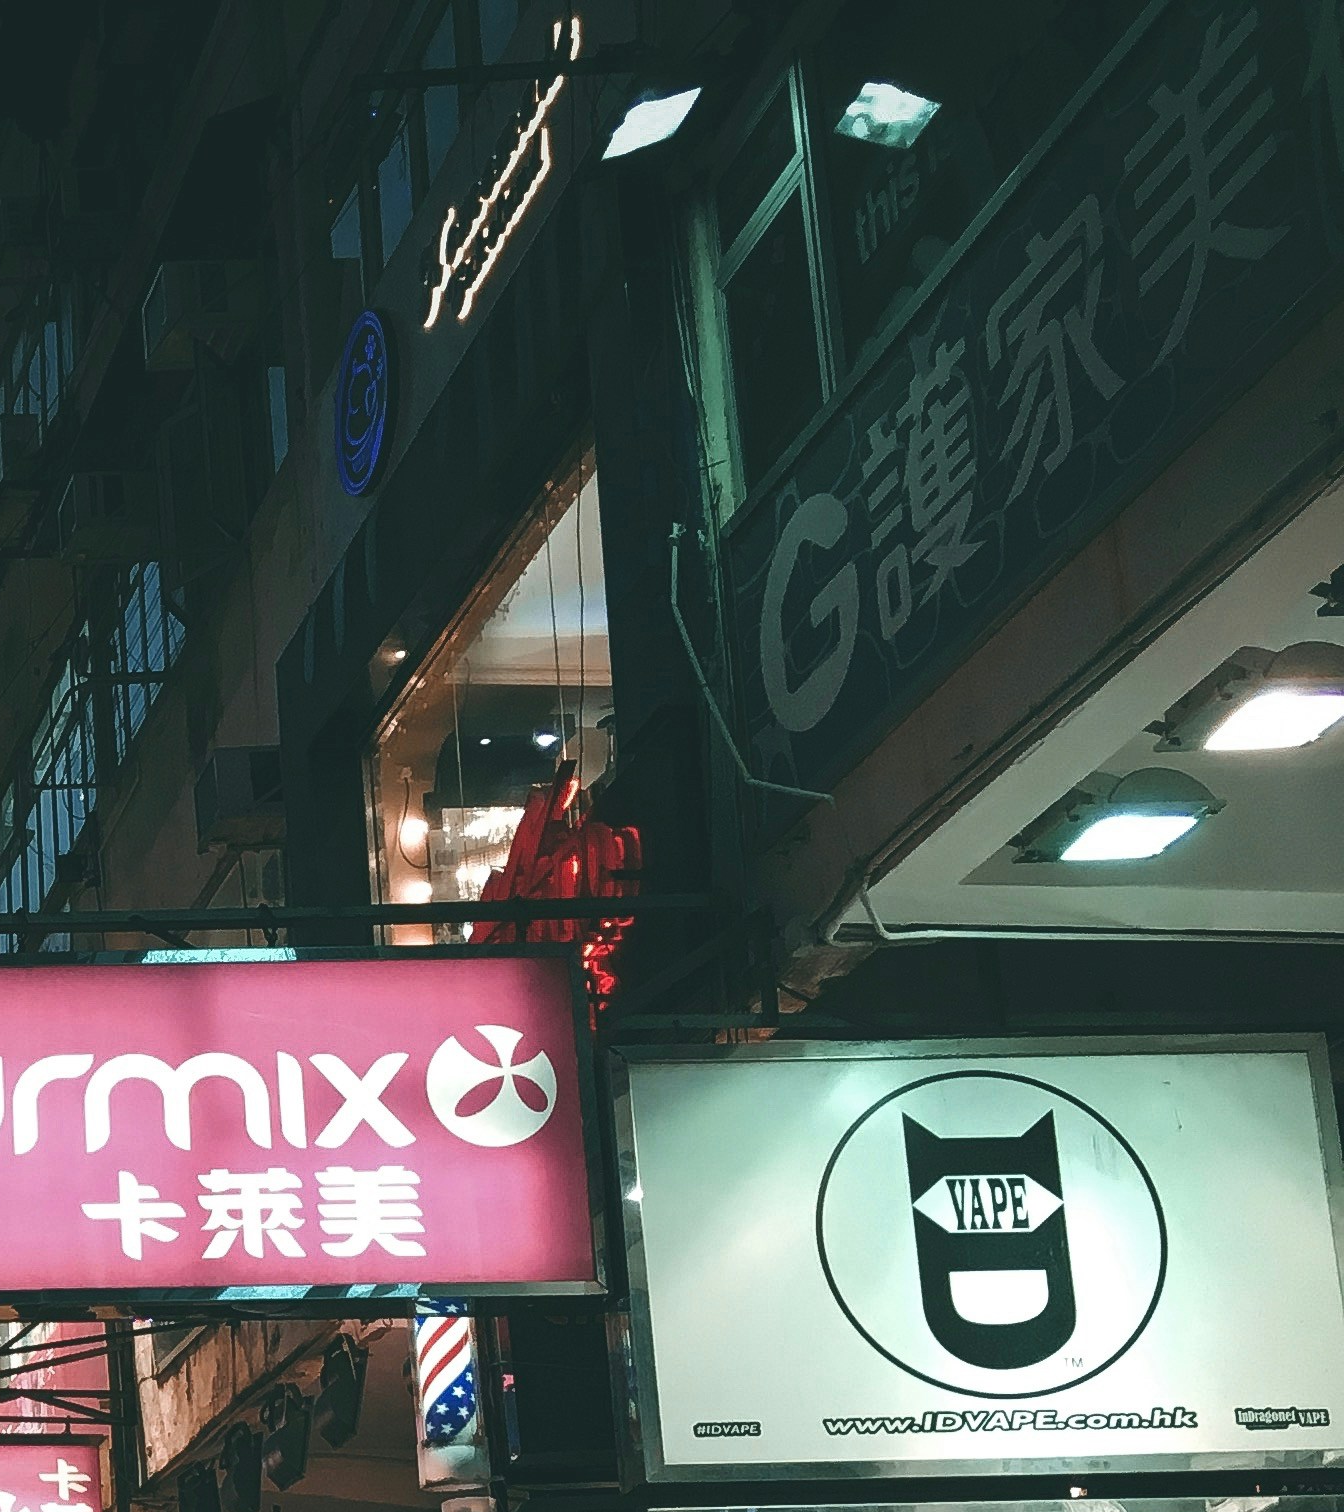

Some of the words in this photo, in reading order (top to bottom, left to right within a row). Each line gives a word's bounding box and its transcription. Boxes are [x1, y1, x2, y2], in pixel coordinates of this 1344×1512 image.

[81, 1166, 427, 1261] 卡萊美
[944, 1175, 1030, 1231] VAPE
[696, 1422, 759, 1437] #IDVAPE
[823, 1406, 1198, 1437] www.IDVAPE.com.hk
[1298, 1411, 1329, 1426] VAPE
